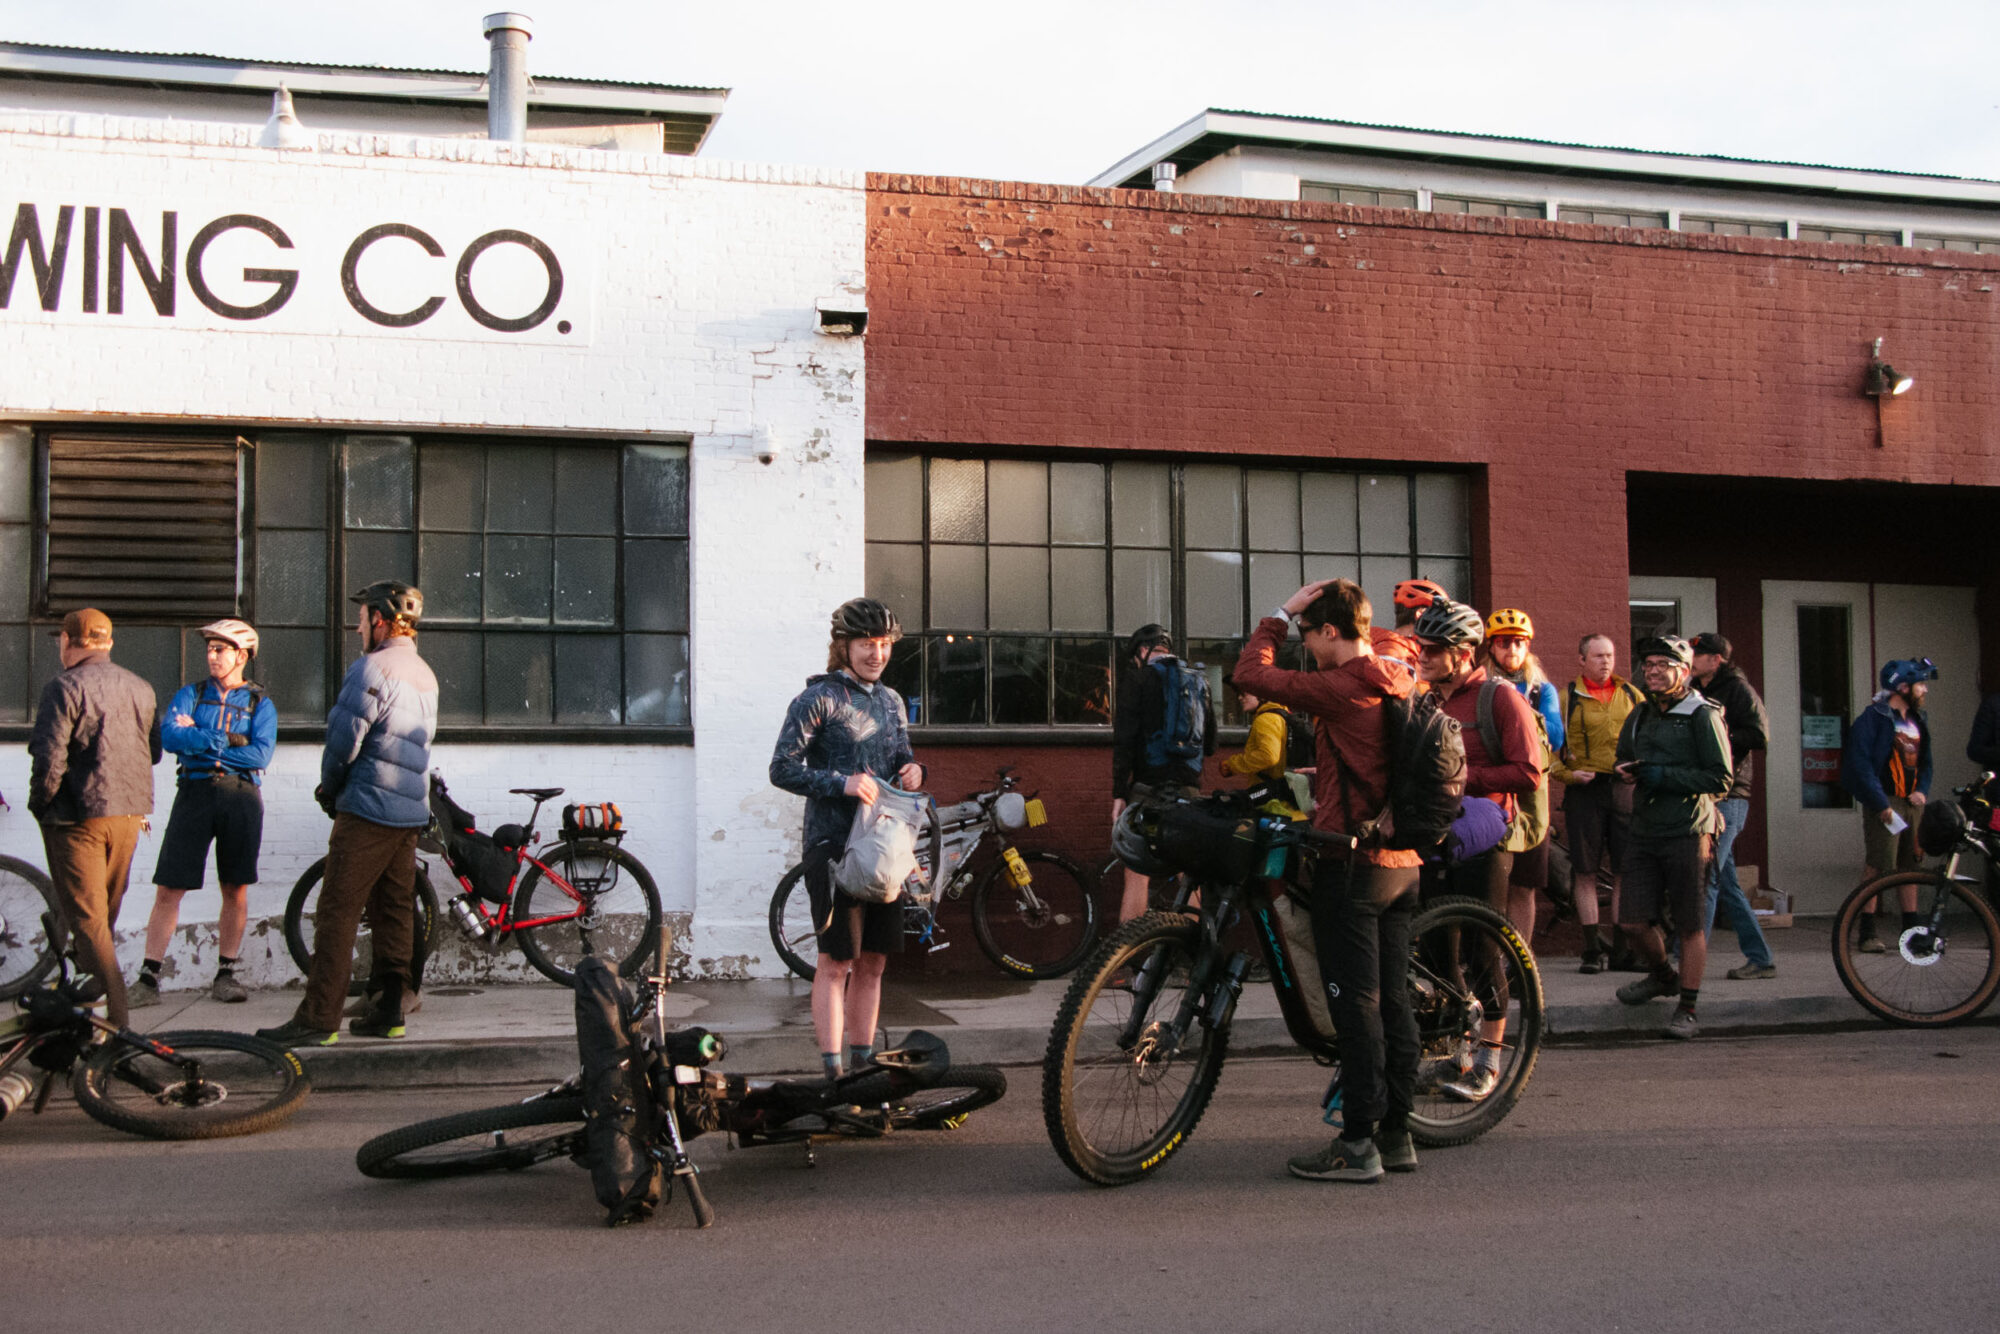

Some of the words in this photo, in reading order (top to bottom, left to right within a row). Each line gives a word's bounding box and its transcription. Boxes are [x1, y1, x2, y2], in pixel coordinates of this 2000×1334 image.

[0, 203, 299, 320] WING
[341, 223, 572, 334] CO.
[1501, 925, 1532, 969] MAXXIS
[1141, 1131, 1182, 1170] MAXXIS
